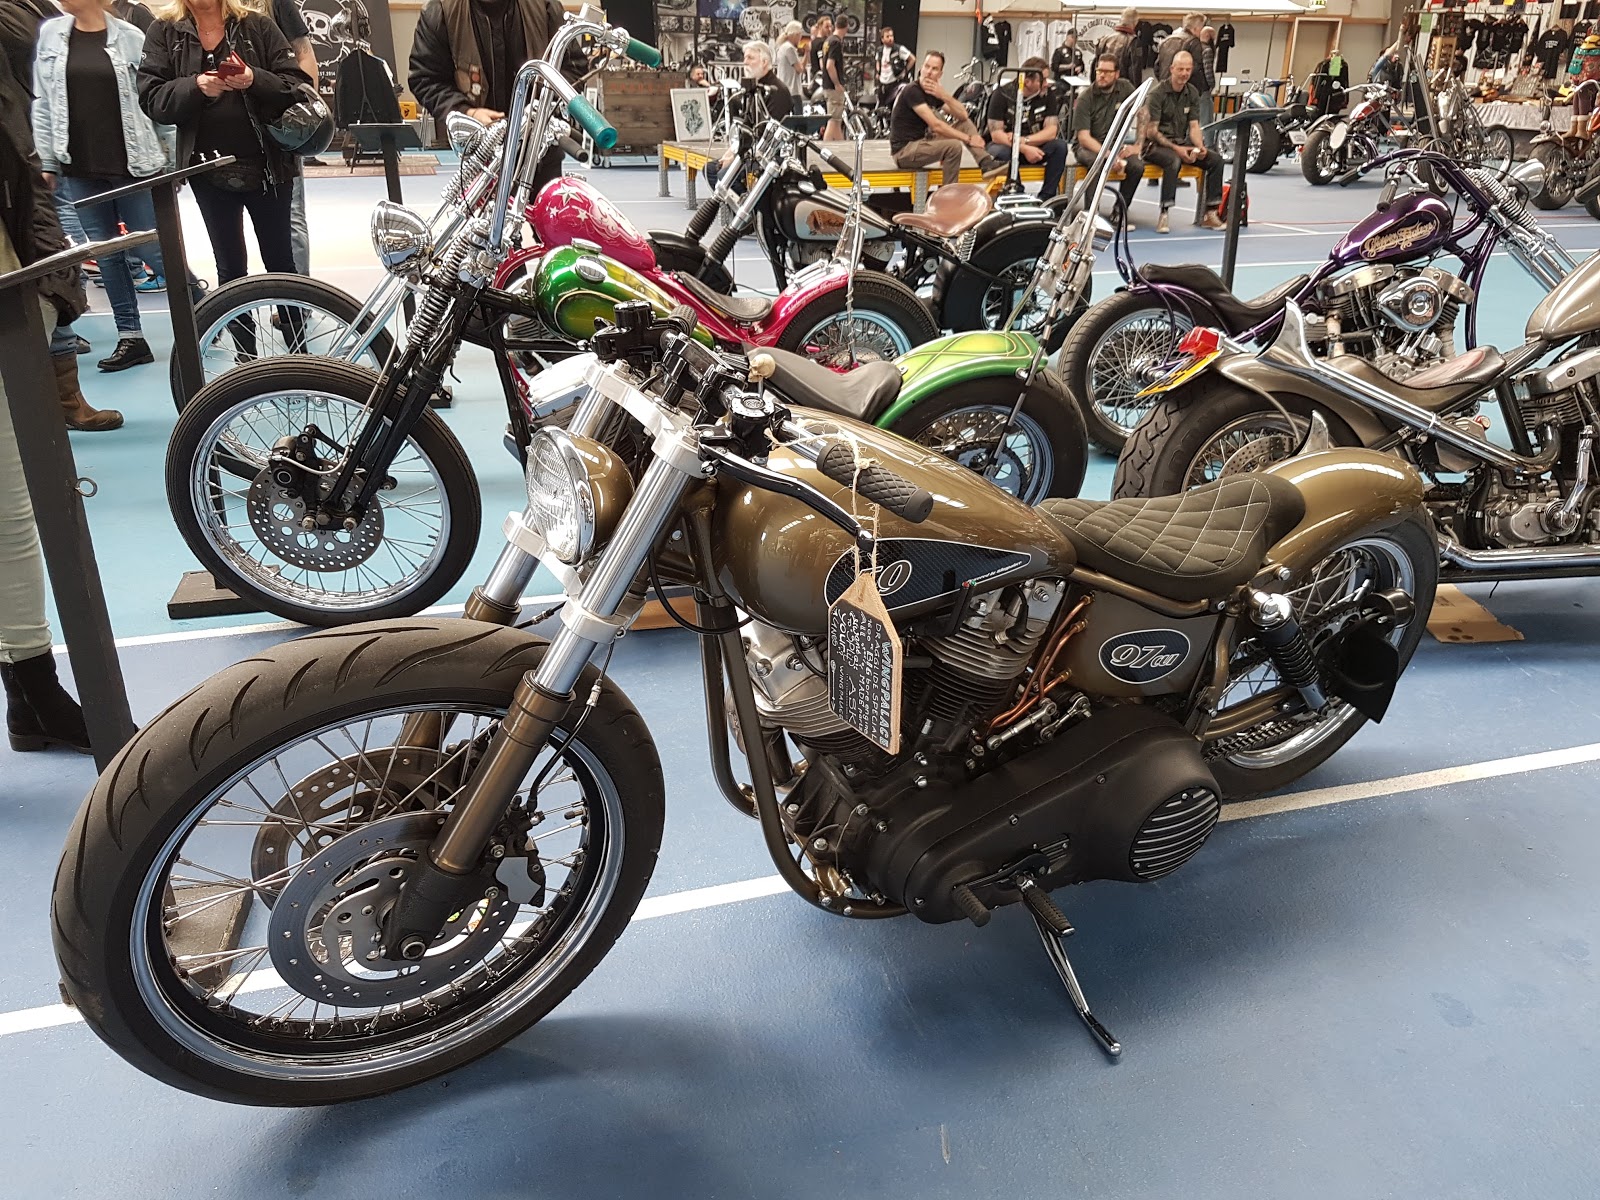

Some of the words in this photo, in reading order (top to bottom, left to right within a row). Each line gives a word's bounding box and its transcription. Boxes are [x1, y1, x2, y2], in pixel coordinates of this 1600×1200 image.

[865, 650, 874, 677] BIG
[848, 674, 857, 725] ASK
[871, 692, 879, 740] SPECIAL
